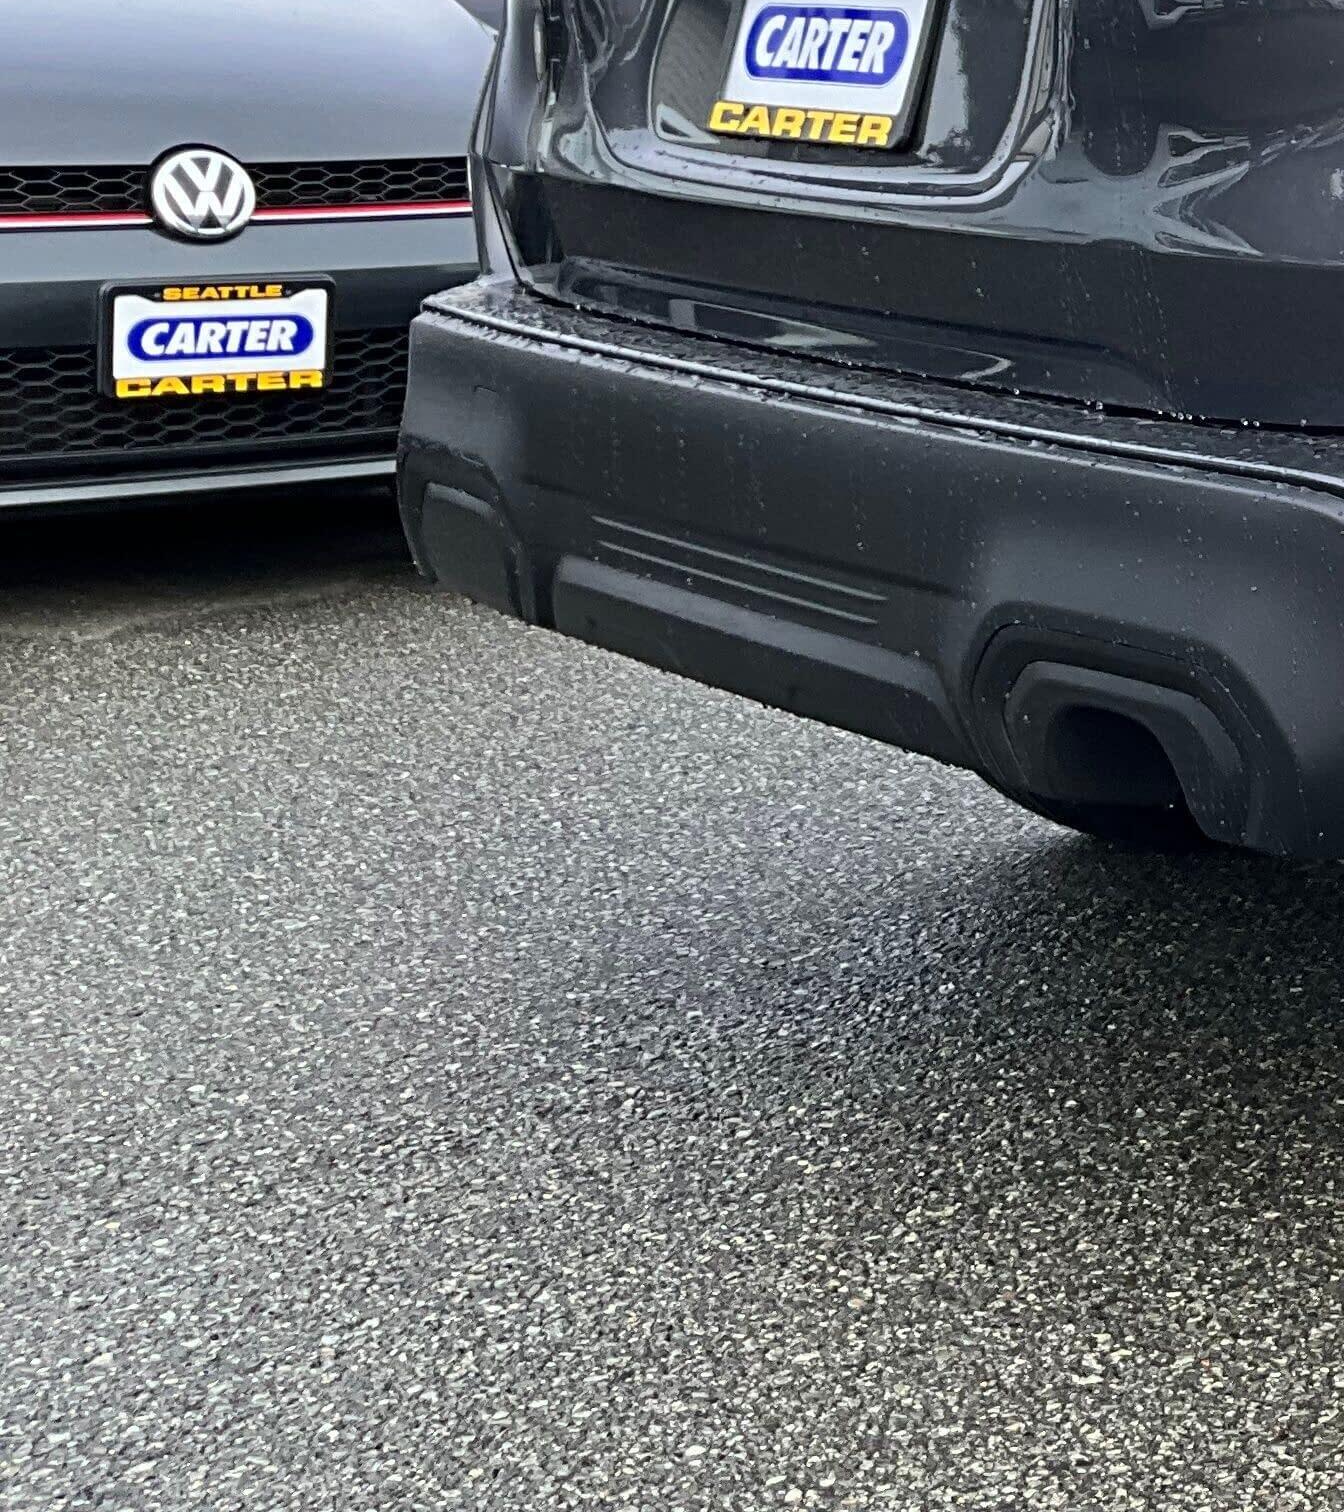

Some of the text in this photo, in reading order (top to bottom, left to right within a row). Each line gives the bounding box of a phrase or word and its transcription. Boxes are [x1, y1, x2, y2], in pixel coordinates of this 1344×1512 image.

[754, 14, 896, 74] CARTER
[708, 100, 893, 146] CARTER
[162, 284, 283, 301] SEATTLE
[141, 319, 298, 356] CARTER
[115, 369, 323, 399] CARTER
